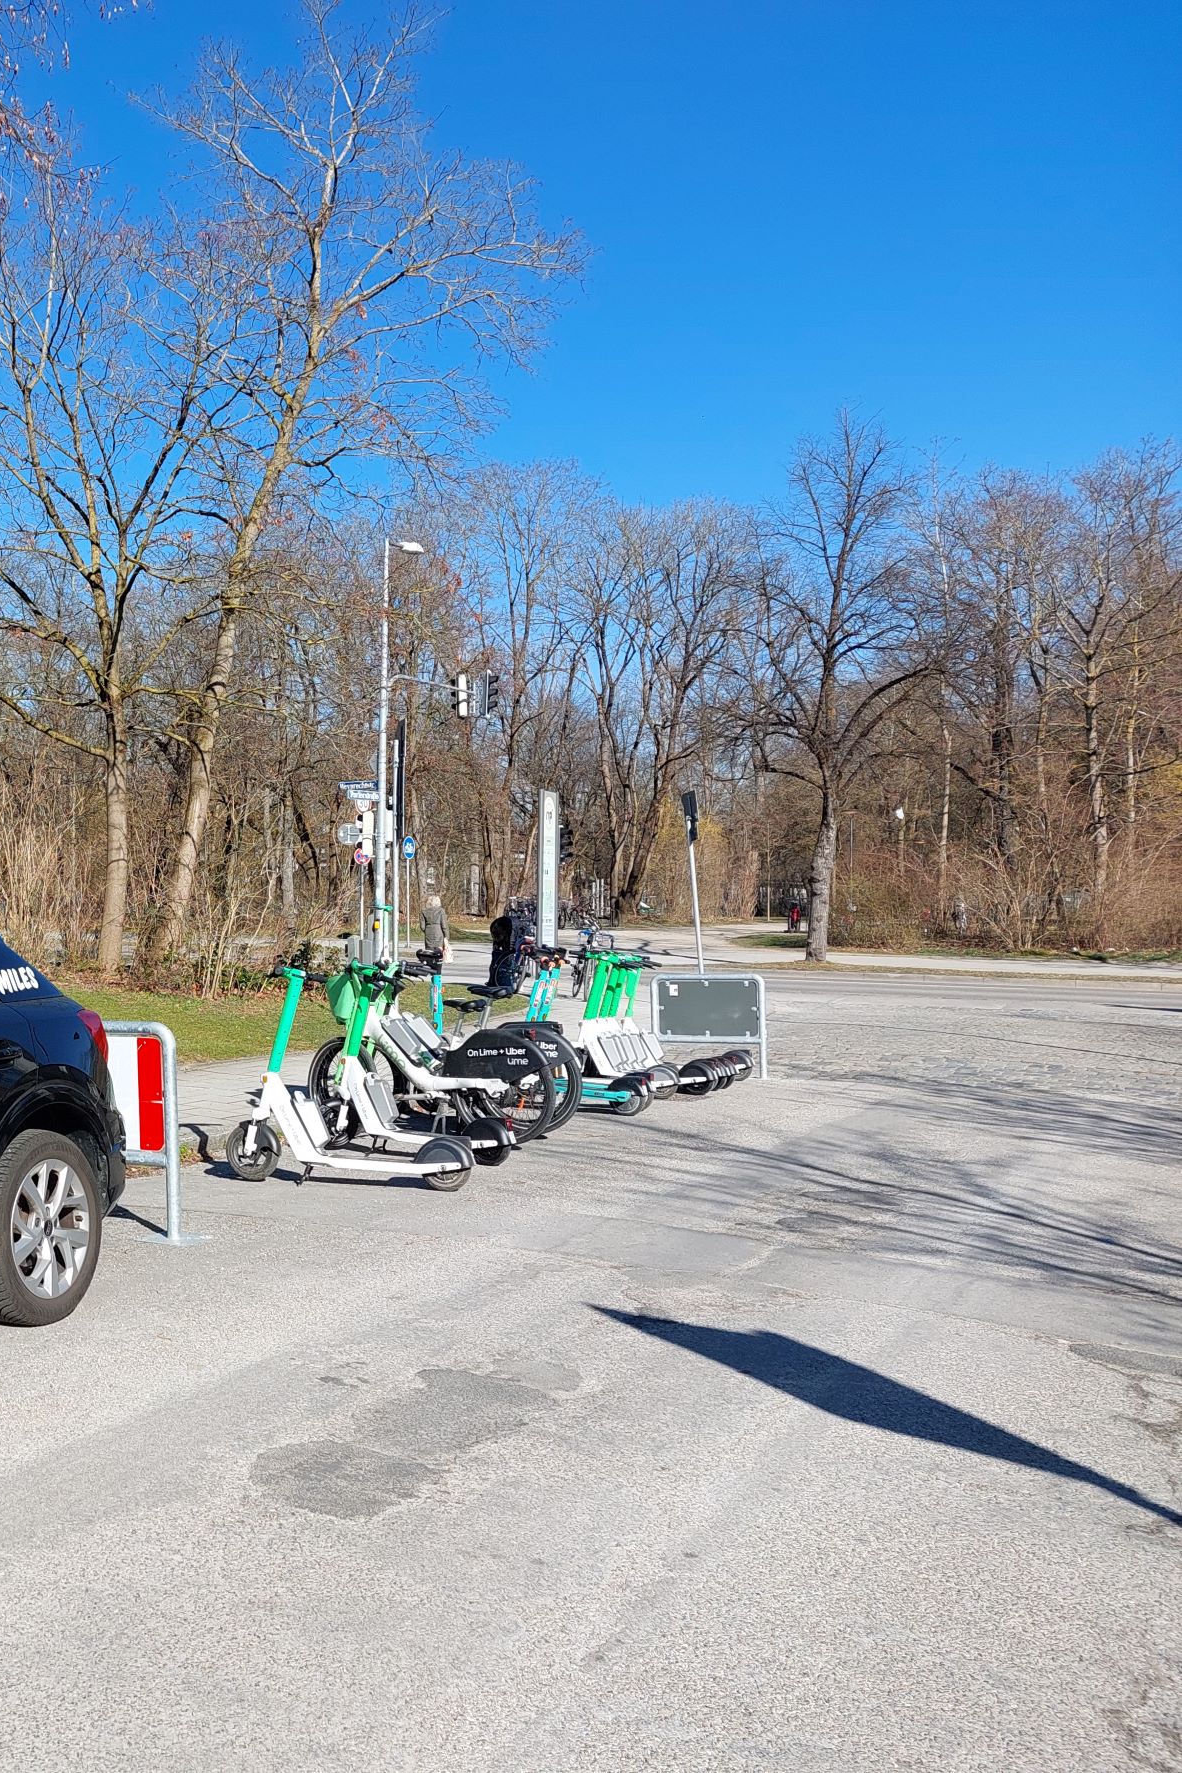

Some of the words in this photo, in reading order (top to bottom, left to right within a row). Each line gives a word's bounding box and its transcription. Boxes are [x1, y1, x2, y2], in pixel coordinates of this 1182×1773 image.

[467, 1049, 478, 1057] On
[479, 1048, 498, 1056] Lime
[505, 1047, 526, 1055] Uber
[507, 1057, 529, 1065] Lime
